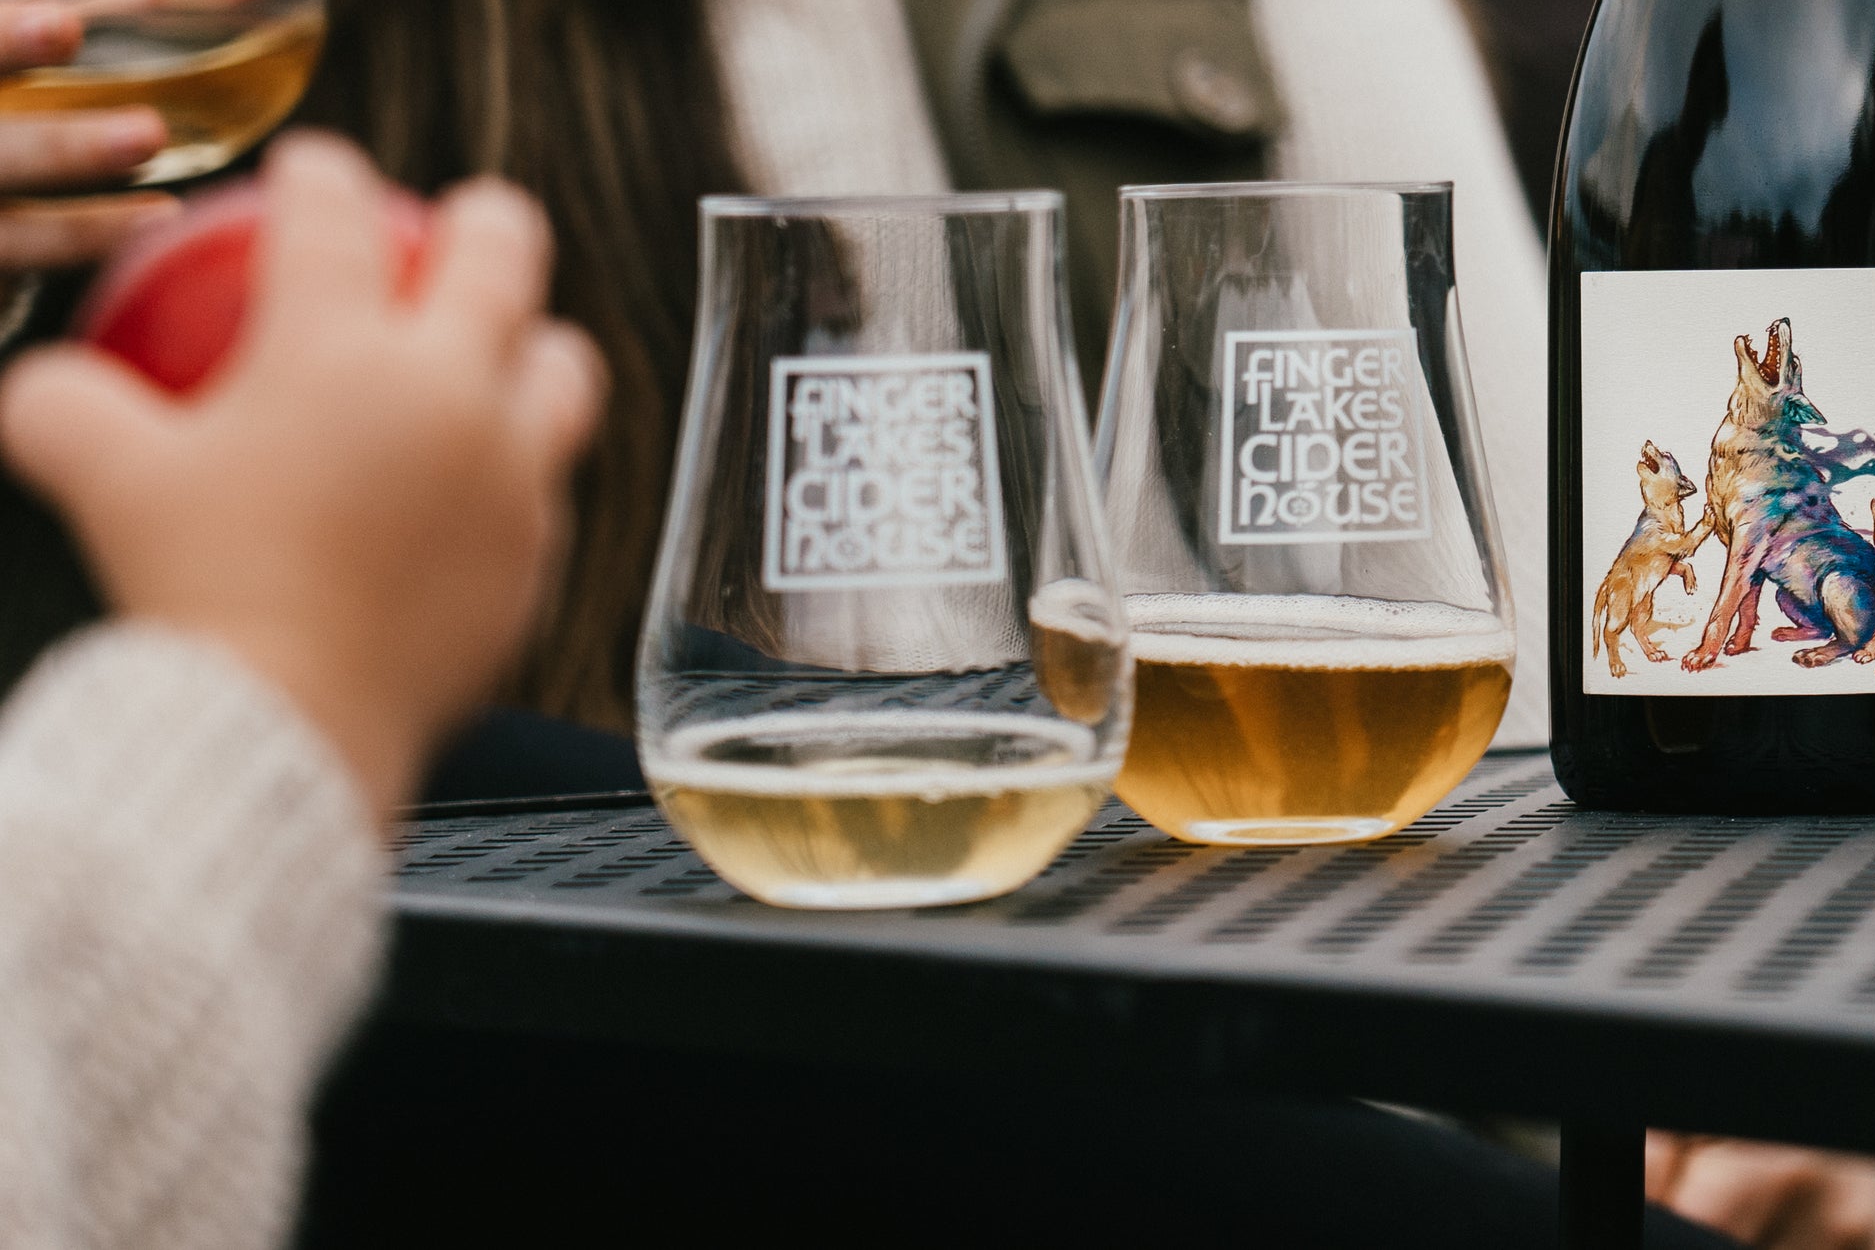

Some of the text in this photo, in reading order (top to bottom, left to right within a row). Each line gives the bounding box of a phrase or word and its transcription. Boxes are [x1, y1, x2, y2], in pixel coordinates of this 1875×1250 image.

[1259, 380, 1404, 431] LAKES
[1239, 431, 1413, 483] CIDER
[788, 467, 982, 520] CIDER
